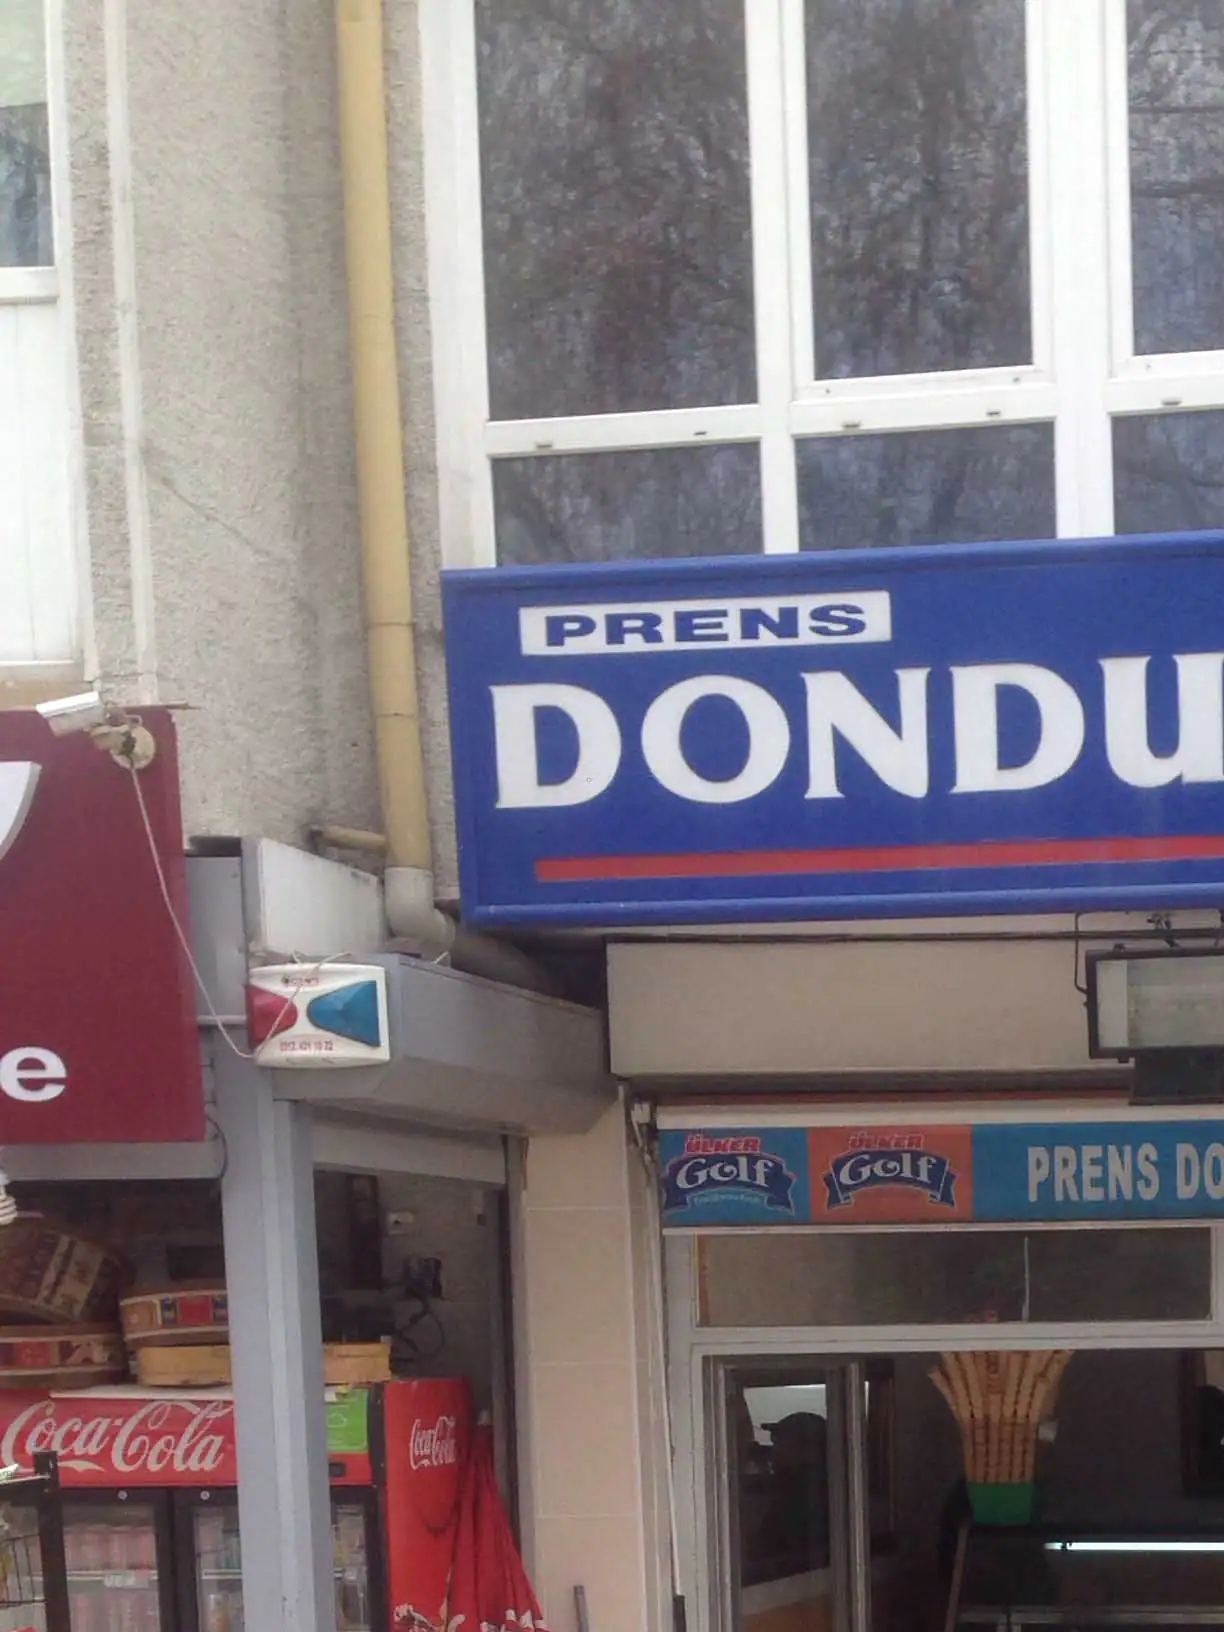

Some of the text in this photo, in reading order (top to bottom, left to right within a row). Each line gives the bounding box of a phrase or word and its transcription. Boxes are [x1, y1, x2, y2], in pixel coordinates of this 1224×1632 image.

[544, 601, 869, 649] PRENS
[685, 1133, 761, 1154] ÜLKER
[848, 1132, 924, 1150] ÜLKER
[676, 1155, 773, 1189] Golf
[839, 1151, 937, 1185] Golf
[1028, 1144, 1160, 1202] PRENS
[1, 1399, 235, 1474] Coca-Cola
[409, 1416, 457, 1471] Coca-Cola
